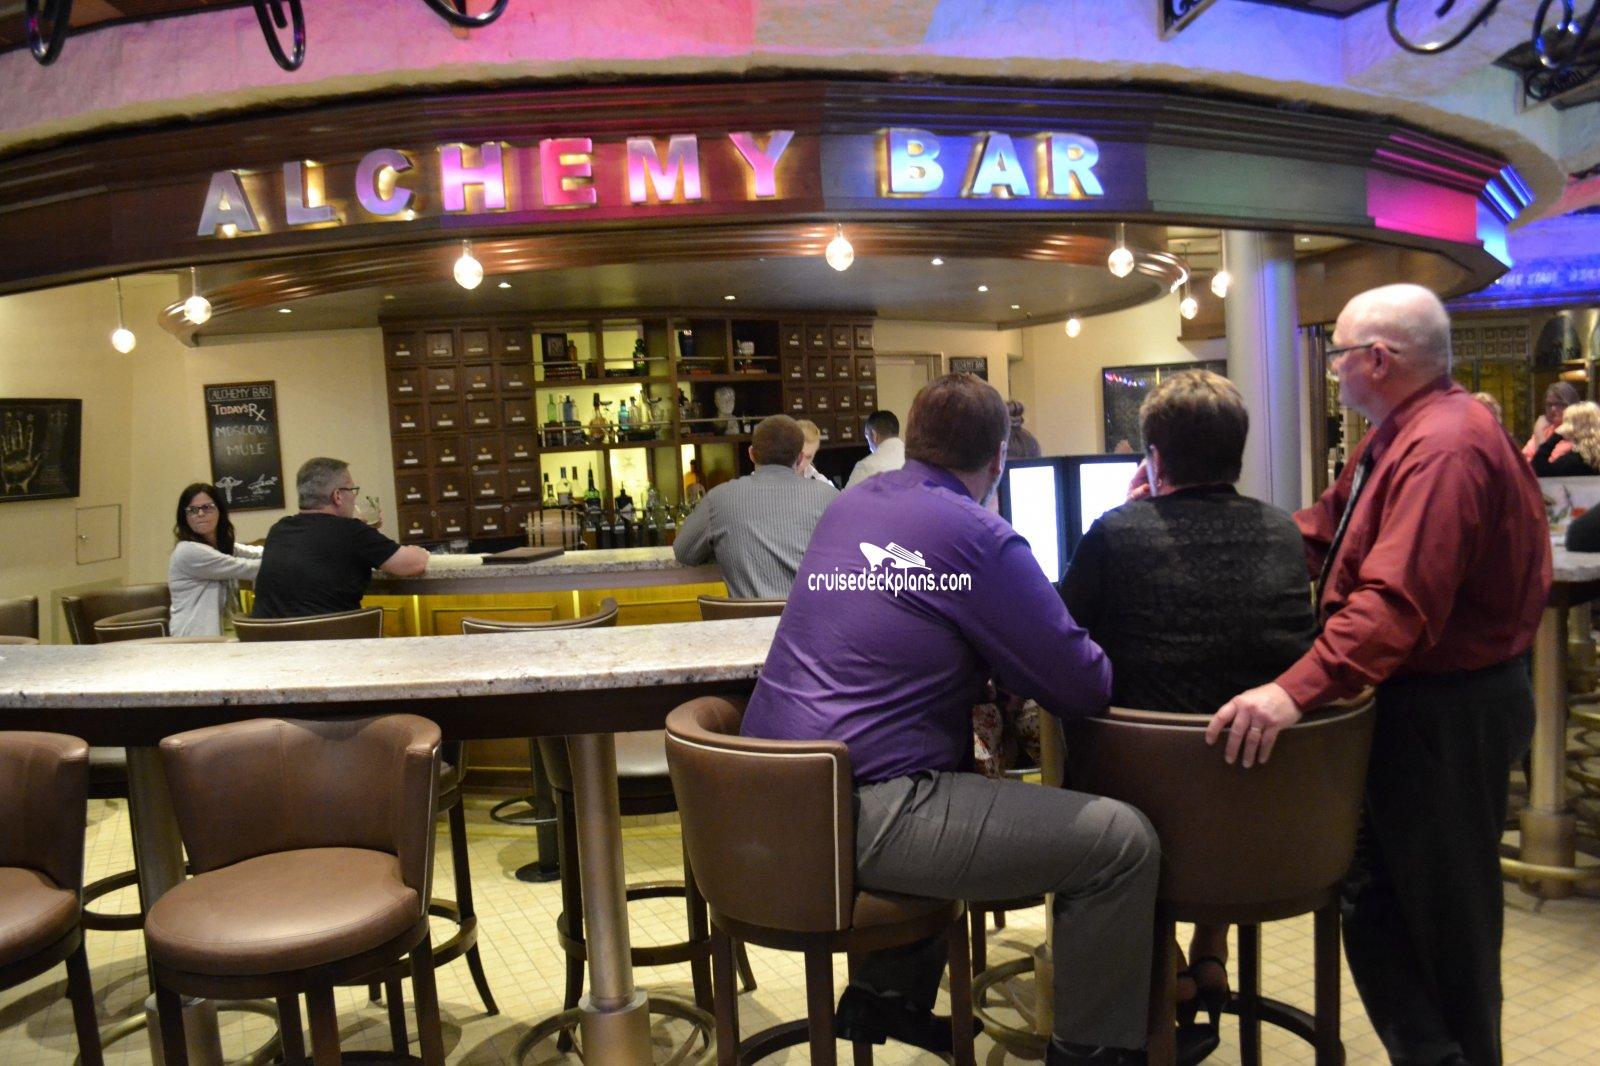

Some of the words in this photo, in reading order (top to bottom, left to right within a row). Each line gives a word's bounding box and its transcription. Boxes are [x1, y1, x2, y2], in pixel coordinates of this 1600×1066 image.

[196, 130, 795, 238] ALCHEMY
[883, 127, 1105, 200] BAR
[252, 386, 270, 397] BAR
[215, 424, 268, 438] MOSCOW
[226, 443, 266, 456] MULE
